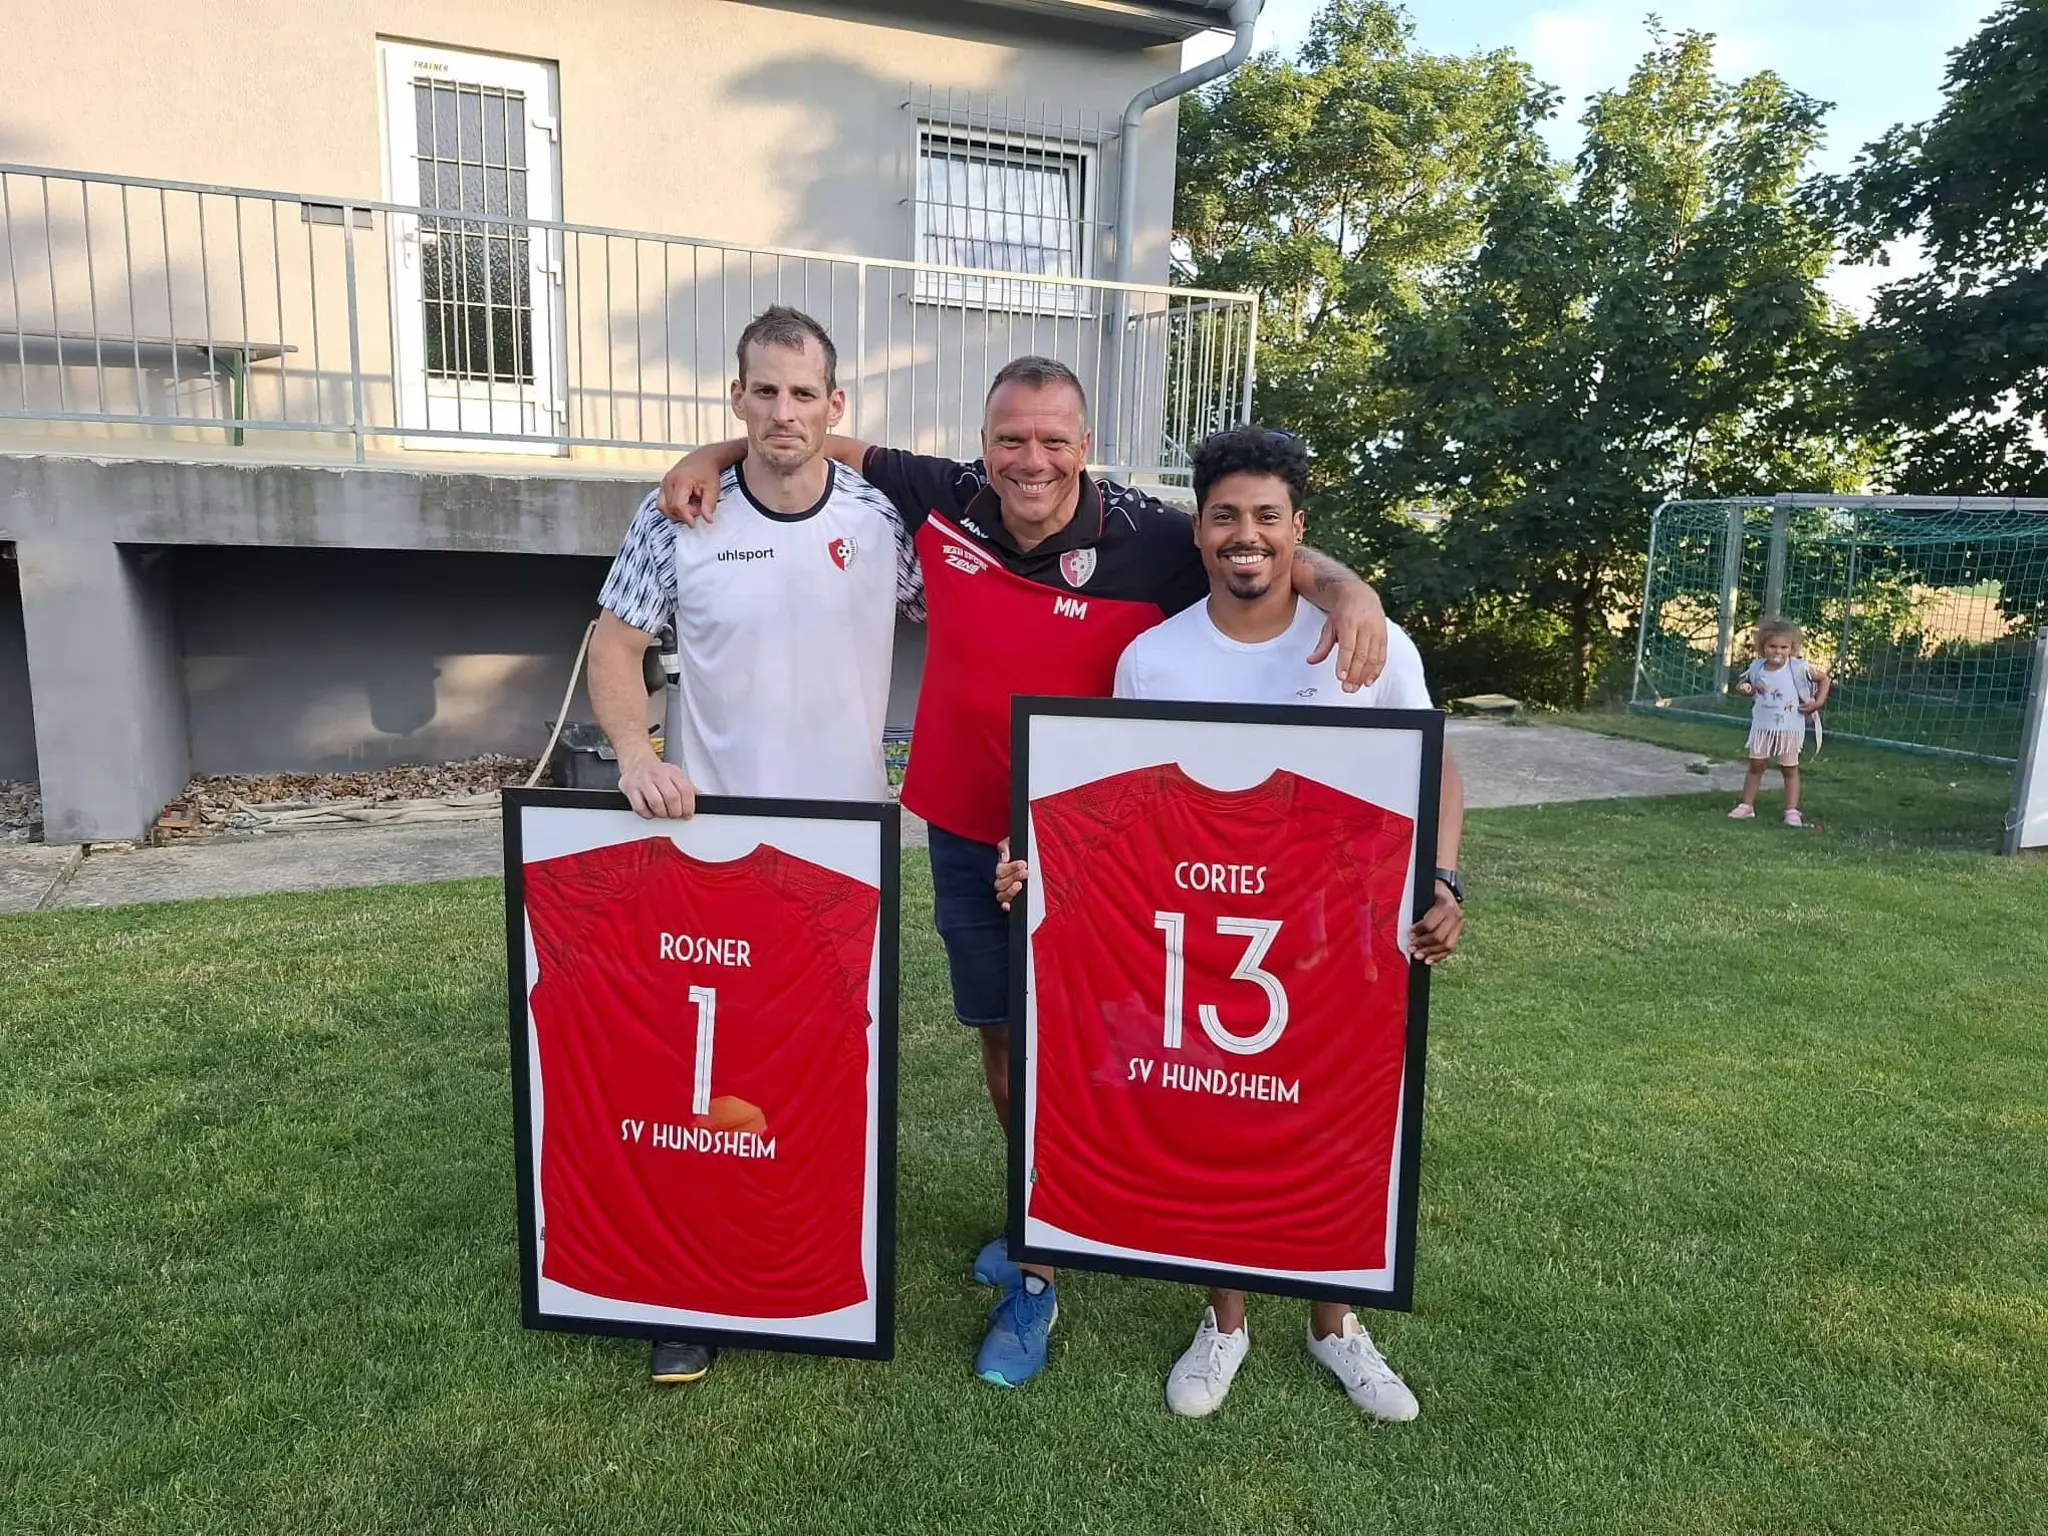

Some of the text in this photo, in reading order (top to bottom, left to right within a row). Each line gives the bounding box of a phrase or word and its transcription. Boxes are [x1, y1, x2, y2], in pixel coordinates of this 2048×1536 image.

[414, 60, 449, 72] TRAINER
[717, 546, 775, 563] uhlsport
[1053, 596, 1088, 620] MM
[1174, 861, 1267, 895] CORTES
[659, 932, 752, 967] ROSNER
[1153, 910, 1289, 1055] 13
[688, 984, 717, 1116] 1
[1127, 1057, 1300, 1104] SV HUNDSHEIM
[620, 1119, 777, 1160] SV HUNDSHEIM
